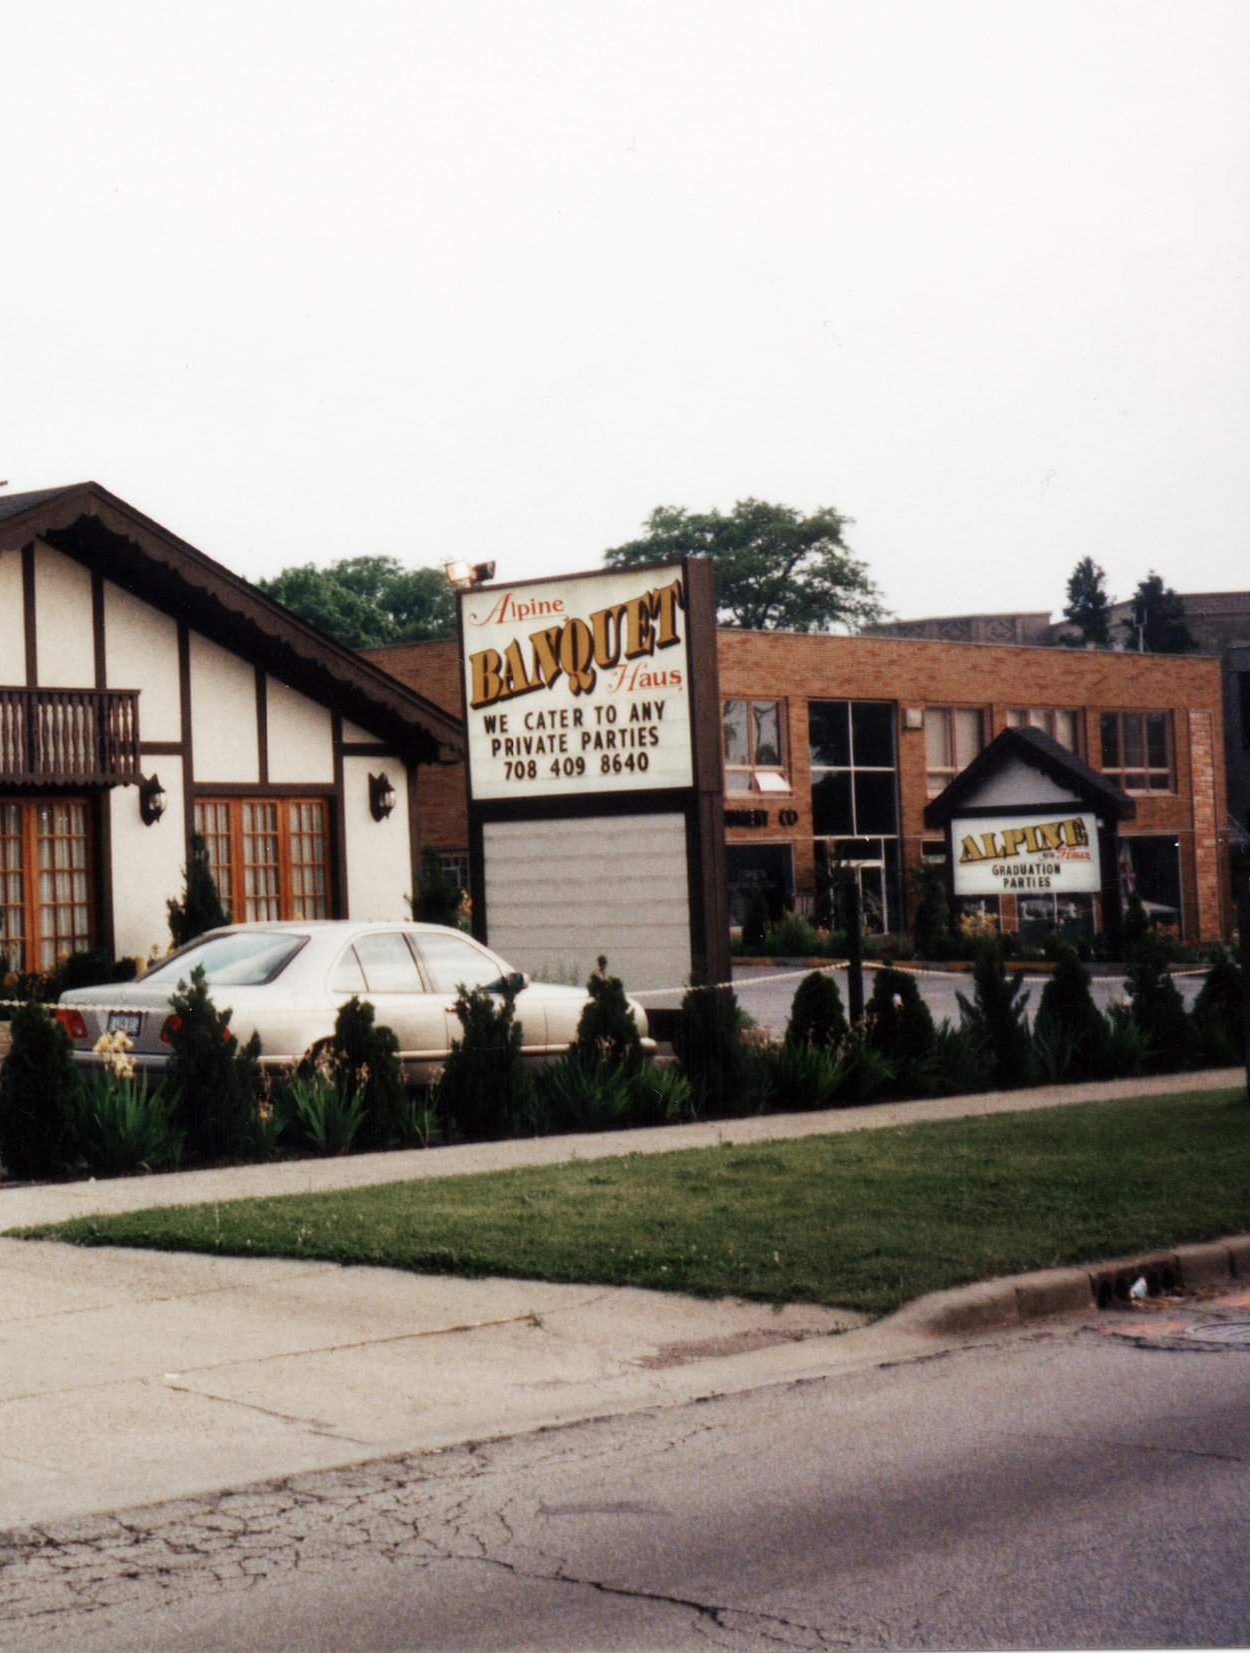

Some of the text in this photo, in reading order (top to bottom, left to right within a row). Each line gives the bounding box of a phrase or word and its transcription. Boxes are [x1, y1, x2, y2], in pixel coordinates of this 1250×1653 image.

[469, 592, 569, 627] Alpine
[469, 578, 684, 710] BANQUET
[607, 661, 683, 694] Haus
[483, 700, 666, 734] WE CATER TO ANY
[491, 726, 660, 757] PRIVATE PARTIES
[504, 751, 649, 781] 708 409 8640
[959, 816, 1089, 864] ALPINE
[992, 863, 1061, 877] GRADUATION
[1003, 876, 1051, 889] PARTIES
